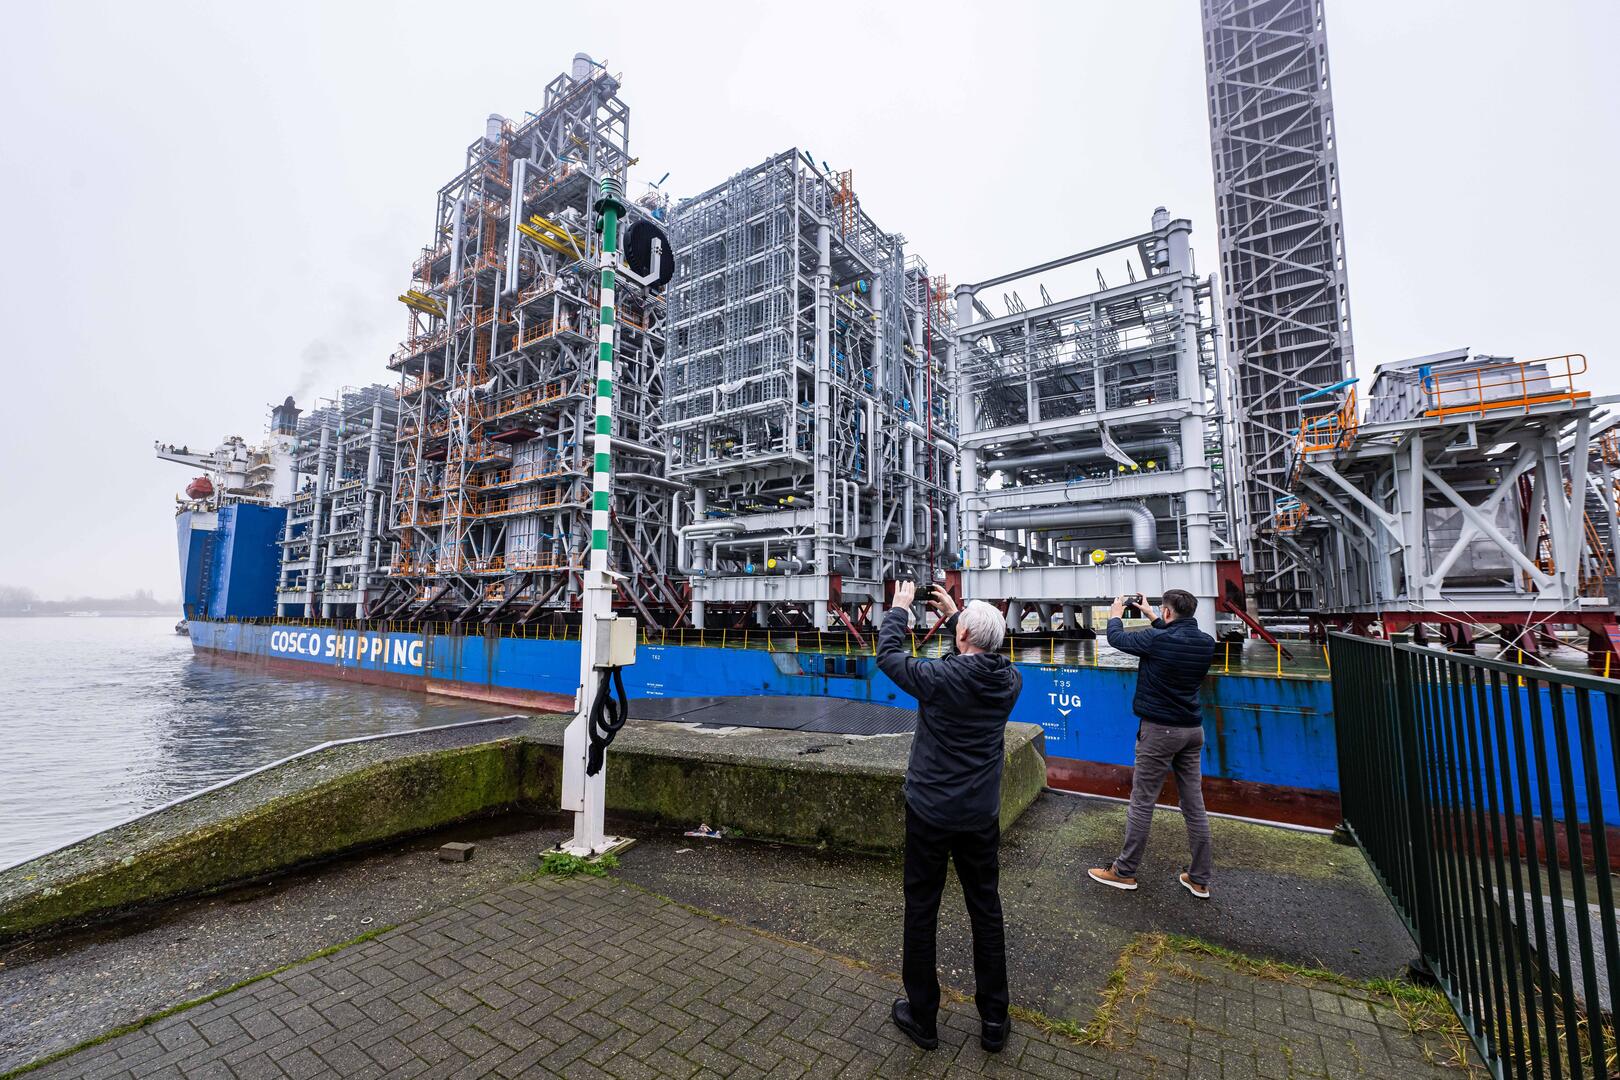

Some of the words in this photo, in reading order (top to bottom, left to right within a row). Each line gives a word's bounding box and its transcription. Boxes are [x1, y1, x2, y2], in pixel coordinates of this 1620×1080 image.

[271, 631, 321, 656] COSCO
[325, 635, 424, 667] SHIPPING
[1048, 693, 1081, 708] TUG
